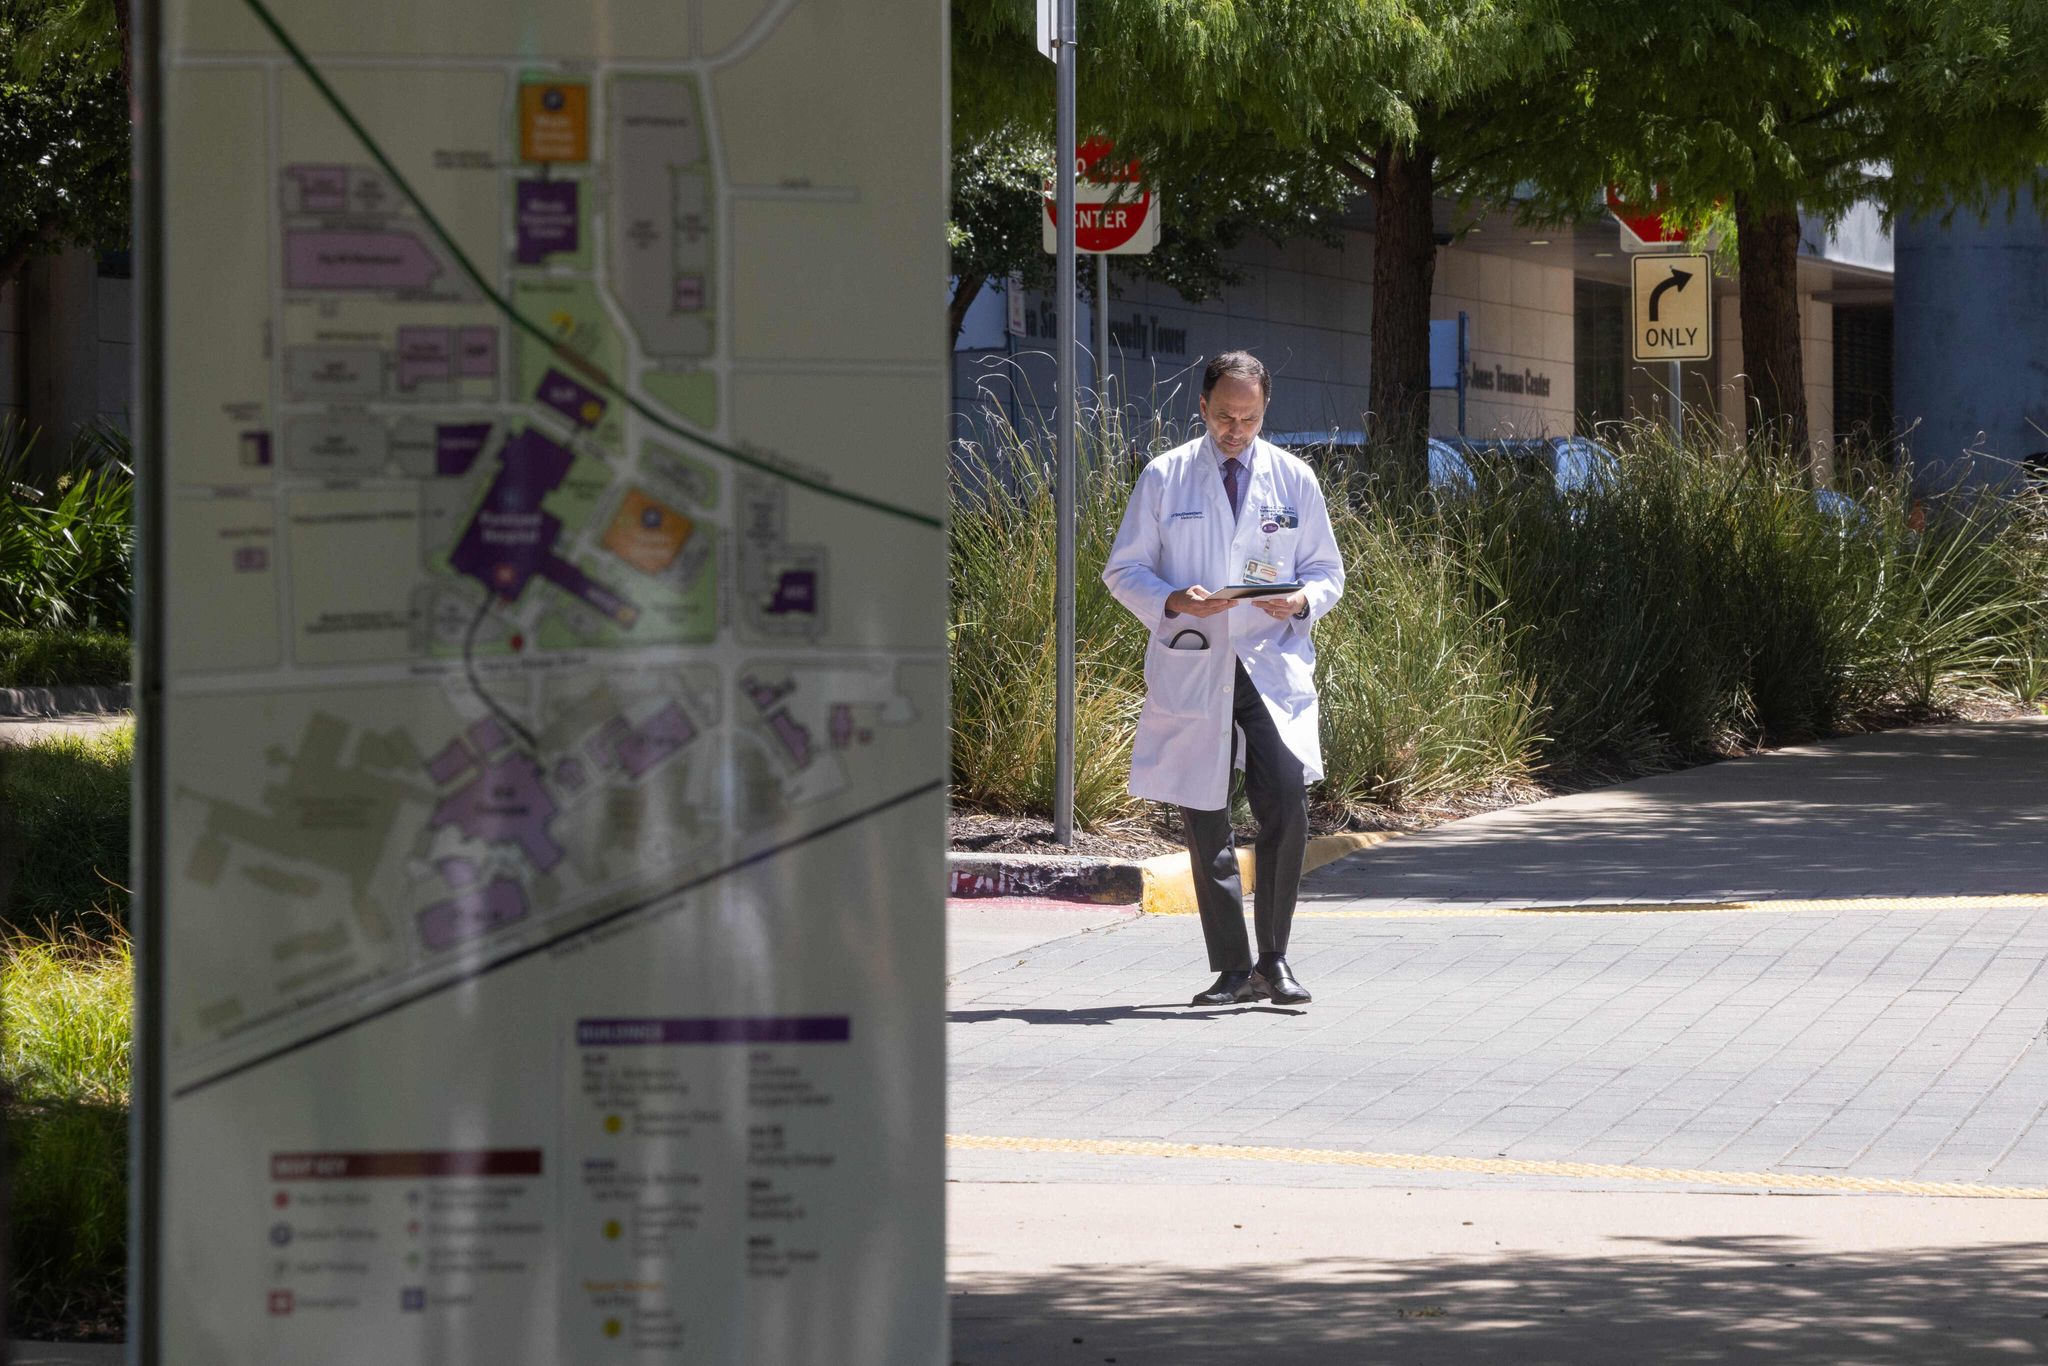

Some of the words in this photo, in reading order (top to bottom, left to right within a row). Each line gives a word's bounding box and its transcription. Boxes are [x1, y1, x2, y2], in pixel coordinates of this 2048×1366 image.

[1150, 316, 1187, 355] Tower
[1645, 327, 1698, 349] ONLY
[1495, 364, 1524, 394] Trauma
[1525, 368, 1550, 397] Center
